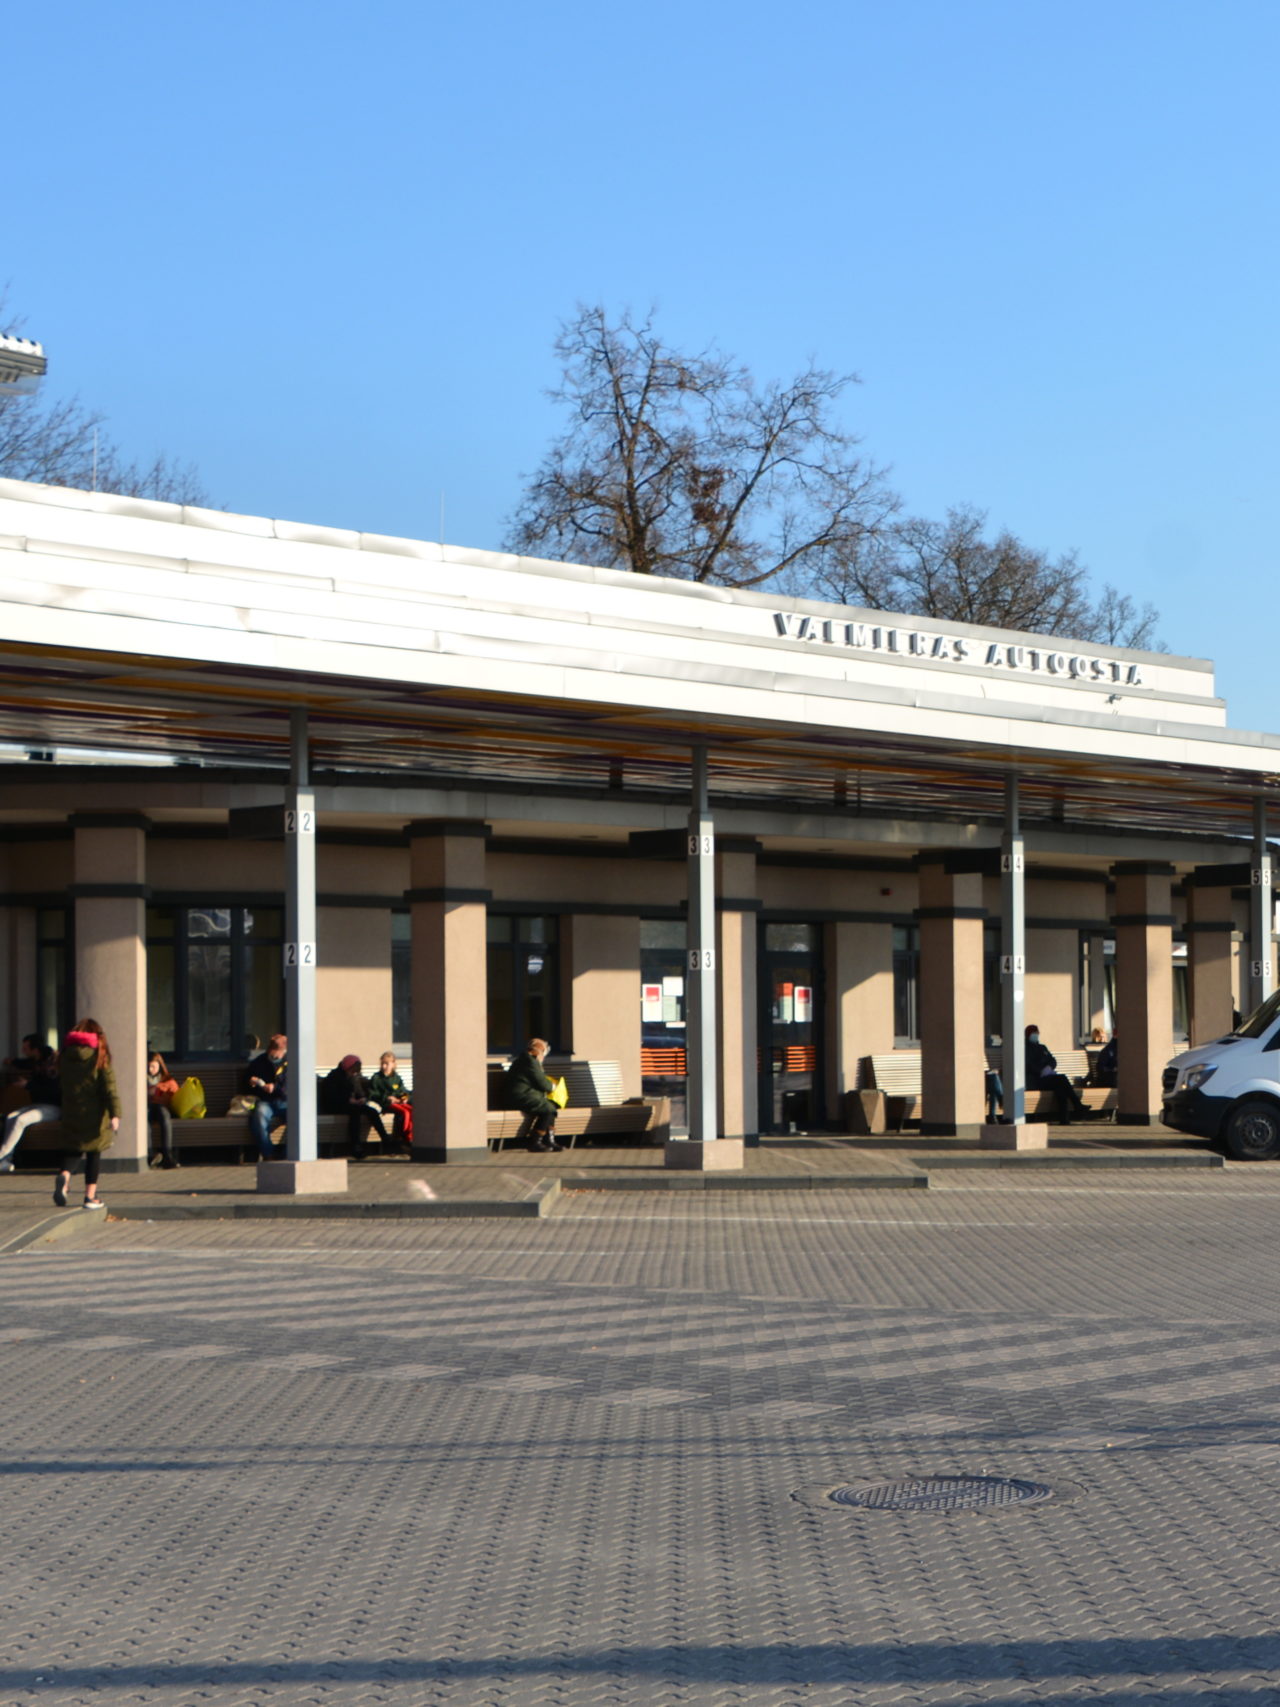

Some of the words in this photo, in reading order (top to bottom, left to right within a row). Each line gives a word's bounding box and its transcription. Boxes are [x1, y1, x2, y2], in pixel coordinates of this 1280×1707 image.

[772, 612, 971, 662] VALMIERAS
[984, 643, 1145, 685] AUTOOSTA
[287, 811, 295, 832] 2
[303, 812, 311, 832] 2
[690, 836, 697, 854] 3
[704, 836, 711, 854] 3
[1003, 855, 1010, 872] 4
[1015, 855, 1022, 871] 4
[1253, 870, 1260, 884] 5
[288, 944, 296, 965] 2
[304, 944, 312, 964] 2
[691, 951, 698, 969] 3
[705, 951, 712, 968] 3
[1004, 956, 1010, 972] 4
[1016, 957, 1022, 972] 4
[1254, 961, 1260, 976] 5
